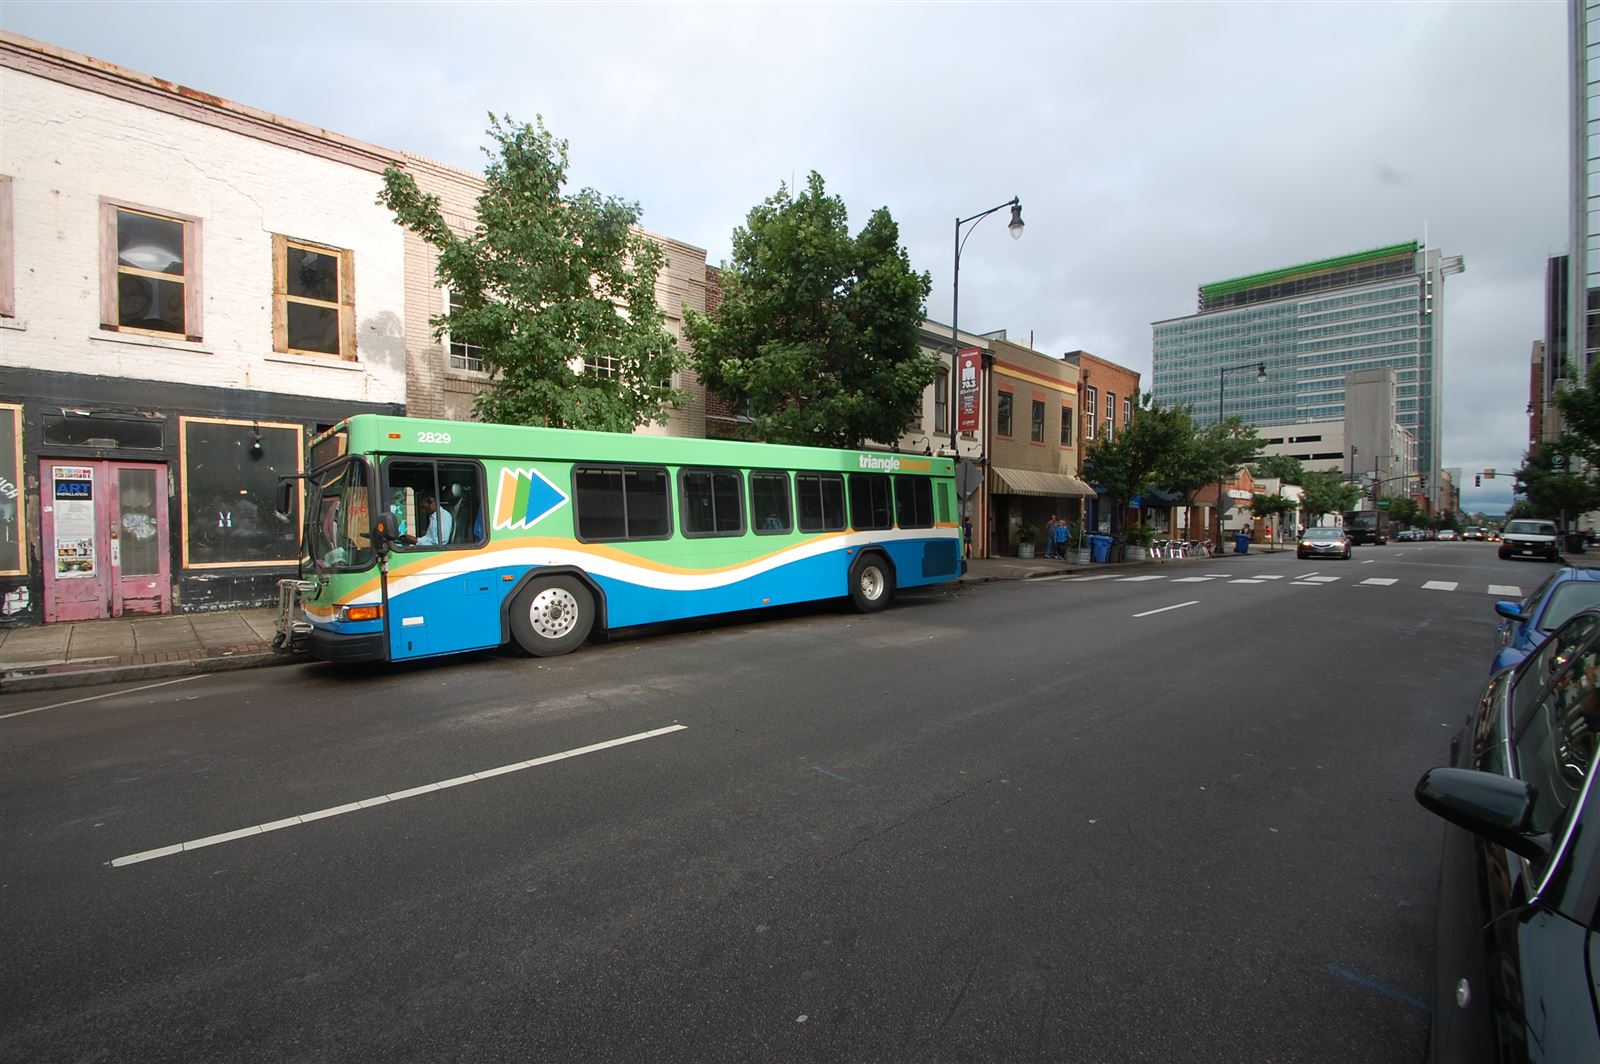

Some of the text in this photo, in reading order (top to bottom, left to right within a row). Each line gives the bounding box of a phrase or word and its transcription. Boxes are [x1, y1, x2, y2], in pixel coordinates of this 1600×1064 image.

[417, 431, 451, 443] 2829
[859, 454, 900, 472] triangle
[57, 483, 90, 492] ART
